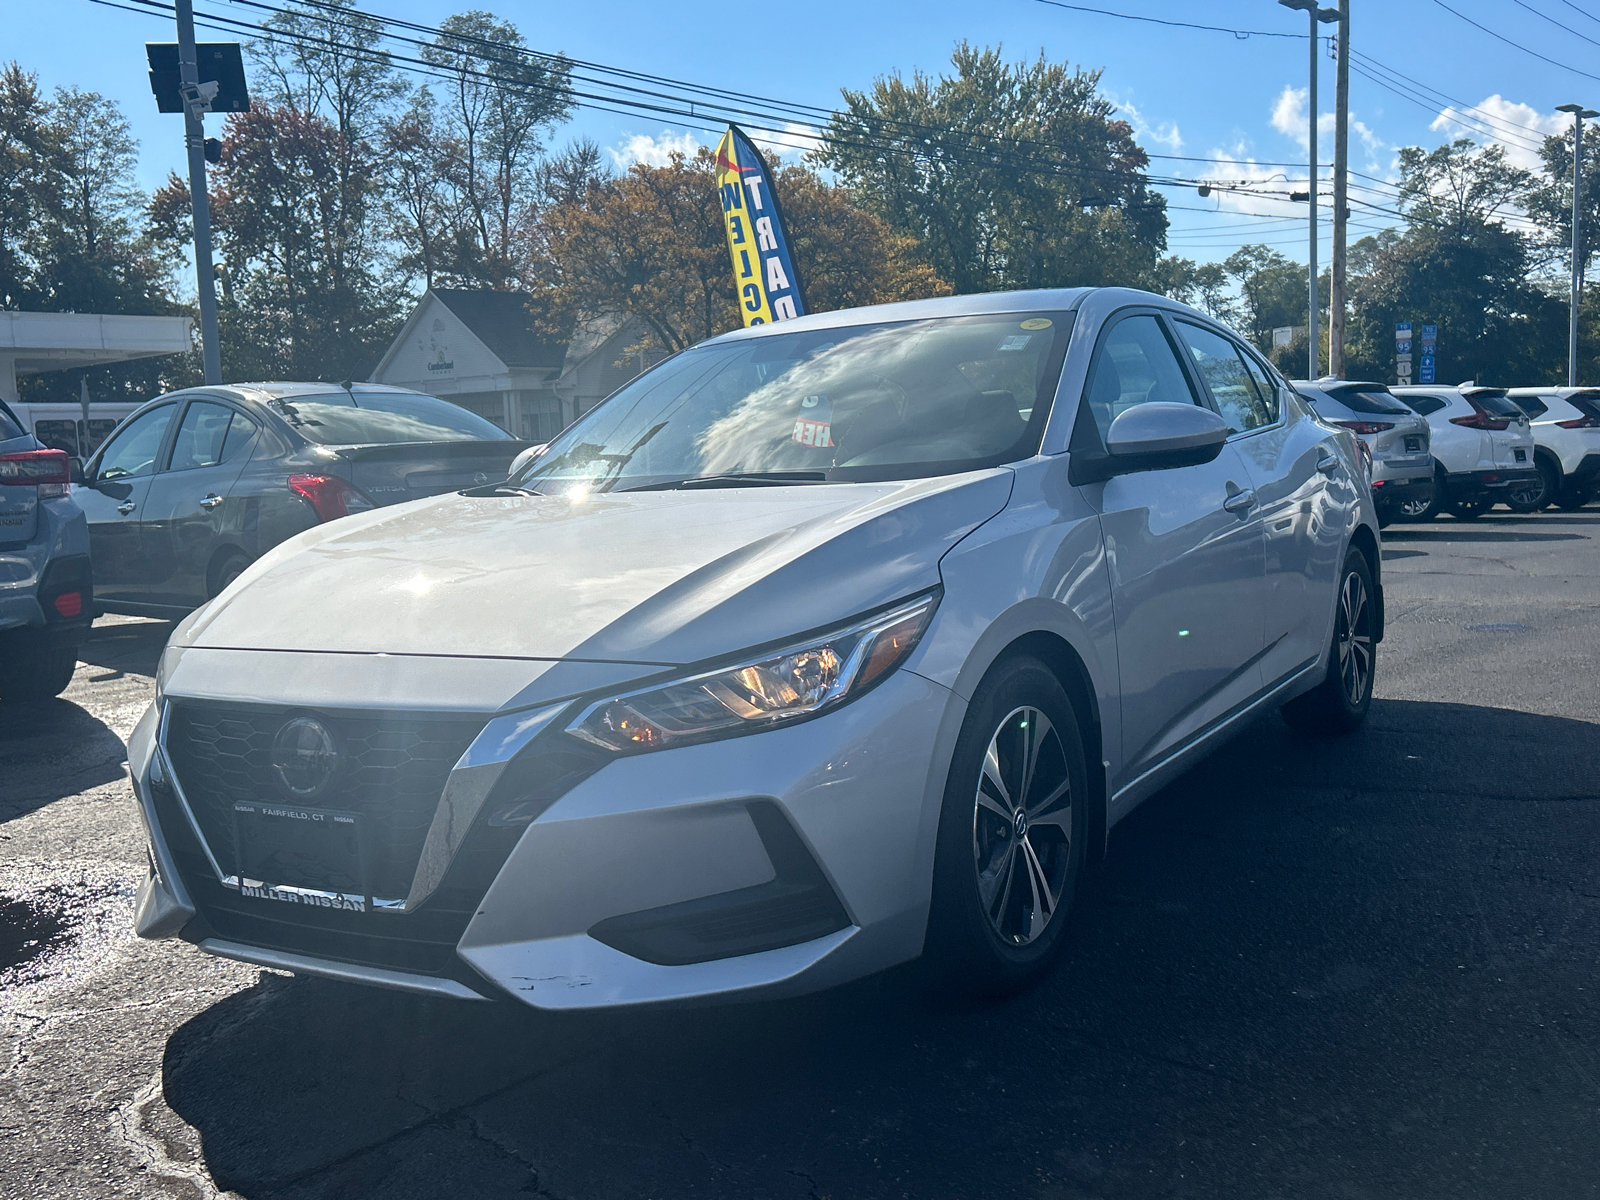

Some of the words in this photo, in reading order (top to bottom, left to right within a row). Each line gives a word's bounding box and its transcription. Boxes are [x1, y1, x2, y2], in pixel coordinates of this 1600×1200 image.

[1398, 343, 1410, 351] 95
[1423, 346, 1434, 355] 95
[366, 485, 406, 493] VERSA
[262, 808, 311, 820] FAIRFIELD,
[312, 813, 325, 821] CT
[241, 886, 299, 903] MILLER
[302, 894, 366, 912] NISSAN
